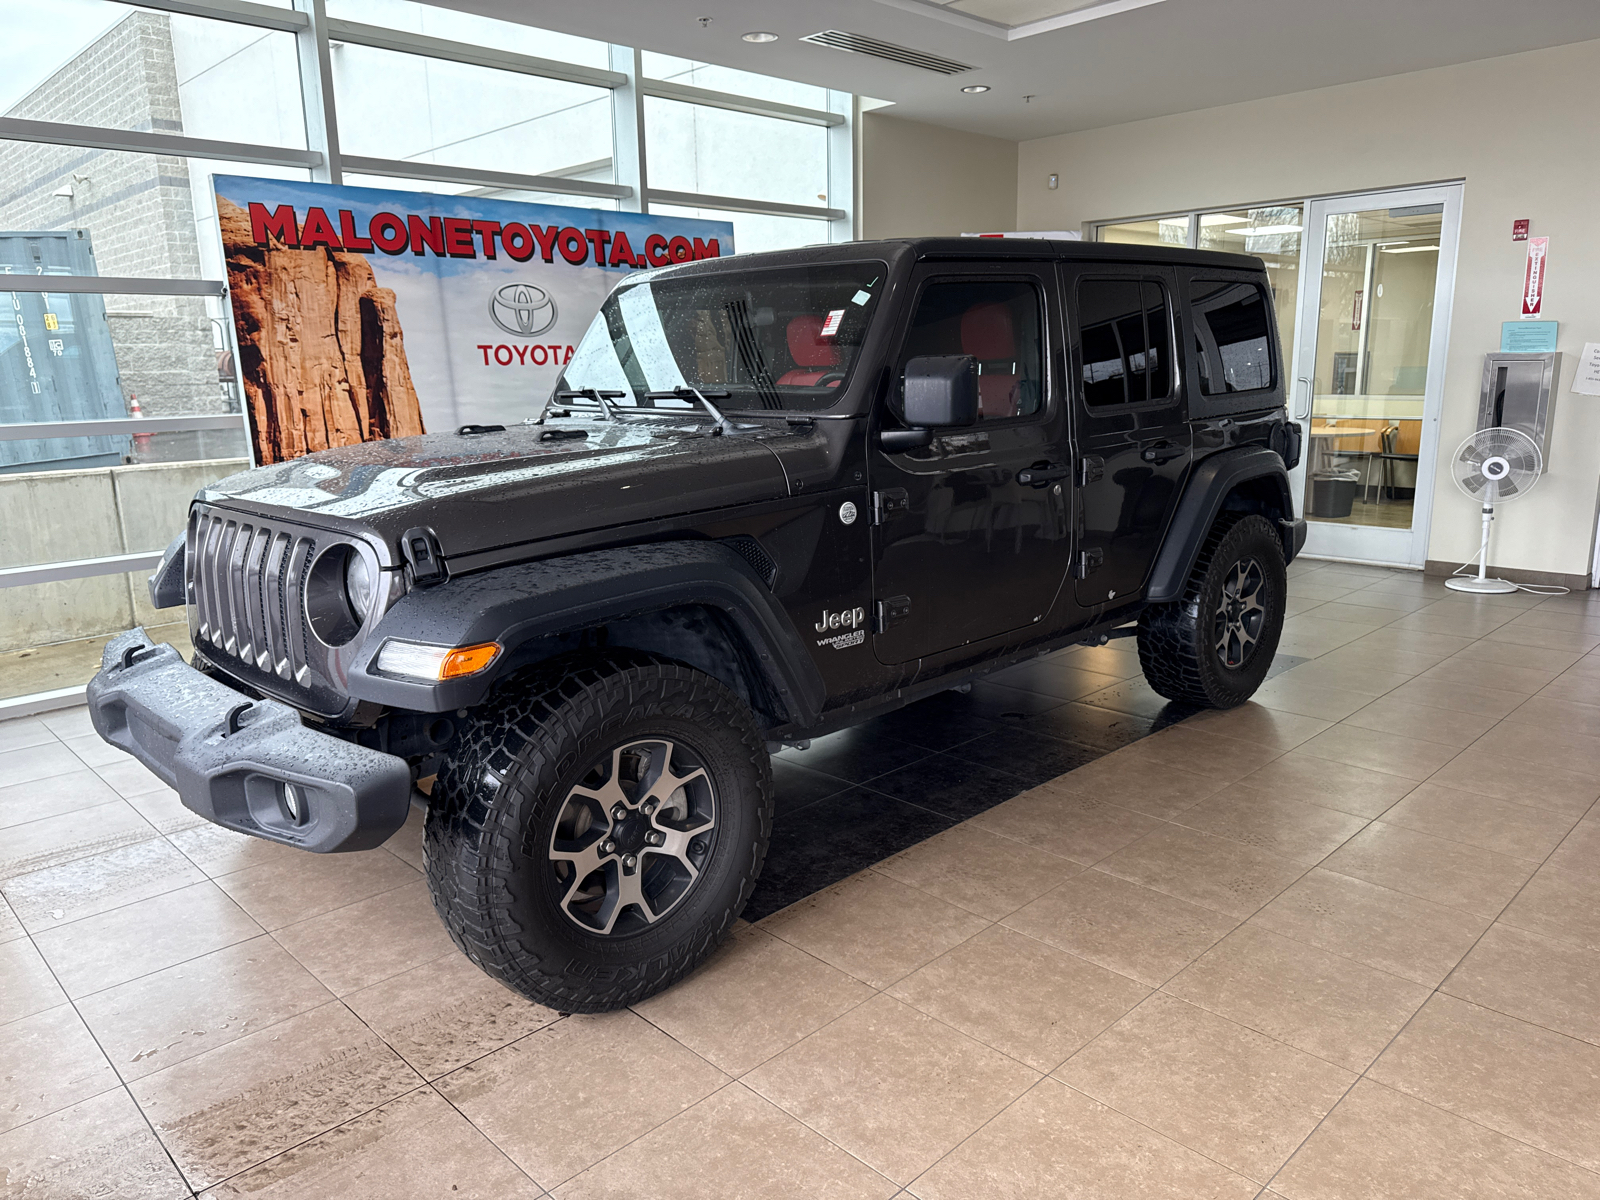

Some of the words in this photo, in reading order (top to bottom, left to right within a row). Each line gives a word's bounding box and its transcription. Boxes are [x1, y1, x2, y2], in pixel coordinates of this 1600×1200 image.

[248, 202, 720, 268] MALONETOYOTA.COM
[1529, 252, 1538, 306] EXTINGUISHER
[477, 344, 575, 366] TOYOTA
[815, 606, 865, 633] Jeep
[816, 630, 865, 646] WRANGLER
